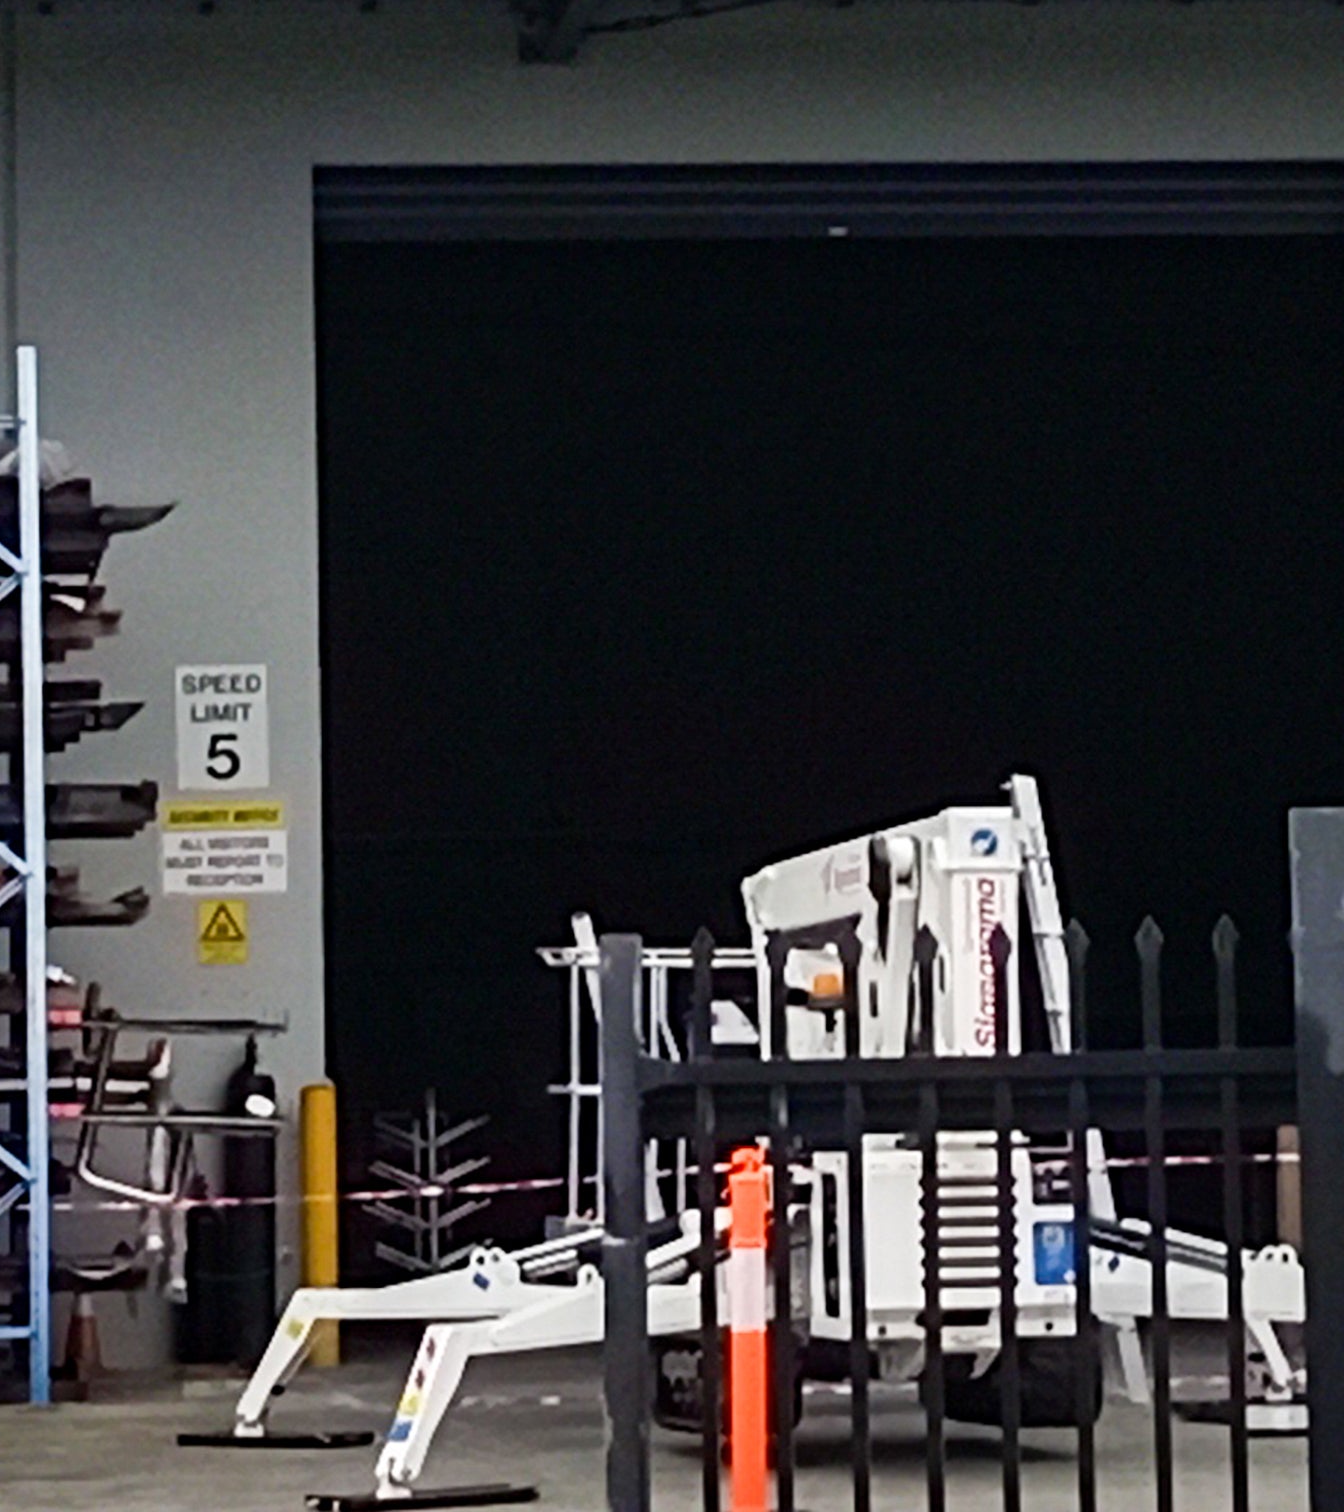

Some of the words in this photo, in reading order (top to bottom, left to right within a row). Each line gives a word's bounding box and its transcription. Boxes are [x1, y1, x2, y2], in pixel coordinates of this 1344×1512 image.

[181, 673, 262, 695] SPEED
[190, 702, 252, 723] LIMIT
[206, 733, 241, 781] 5
